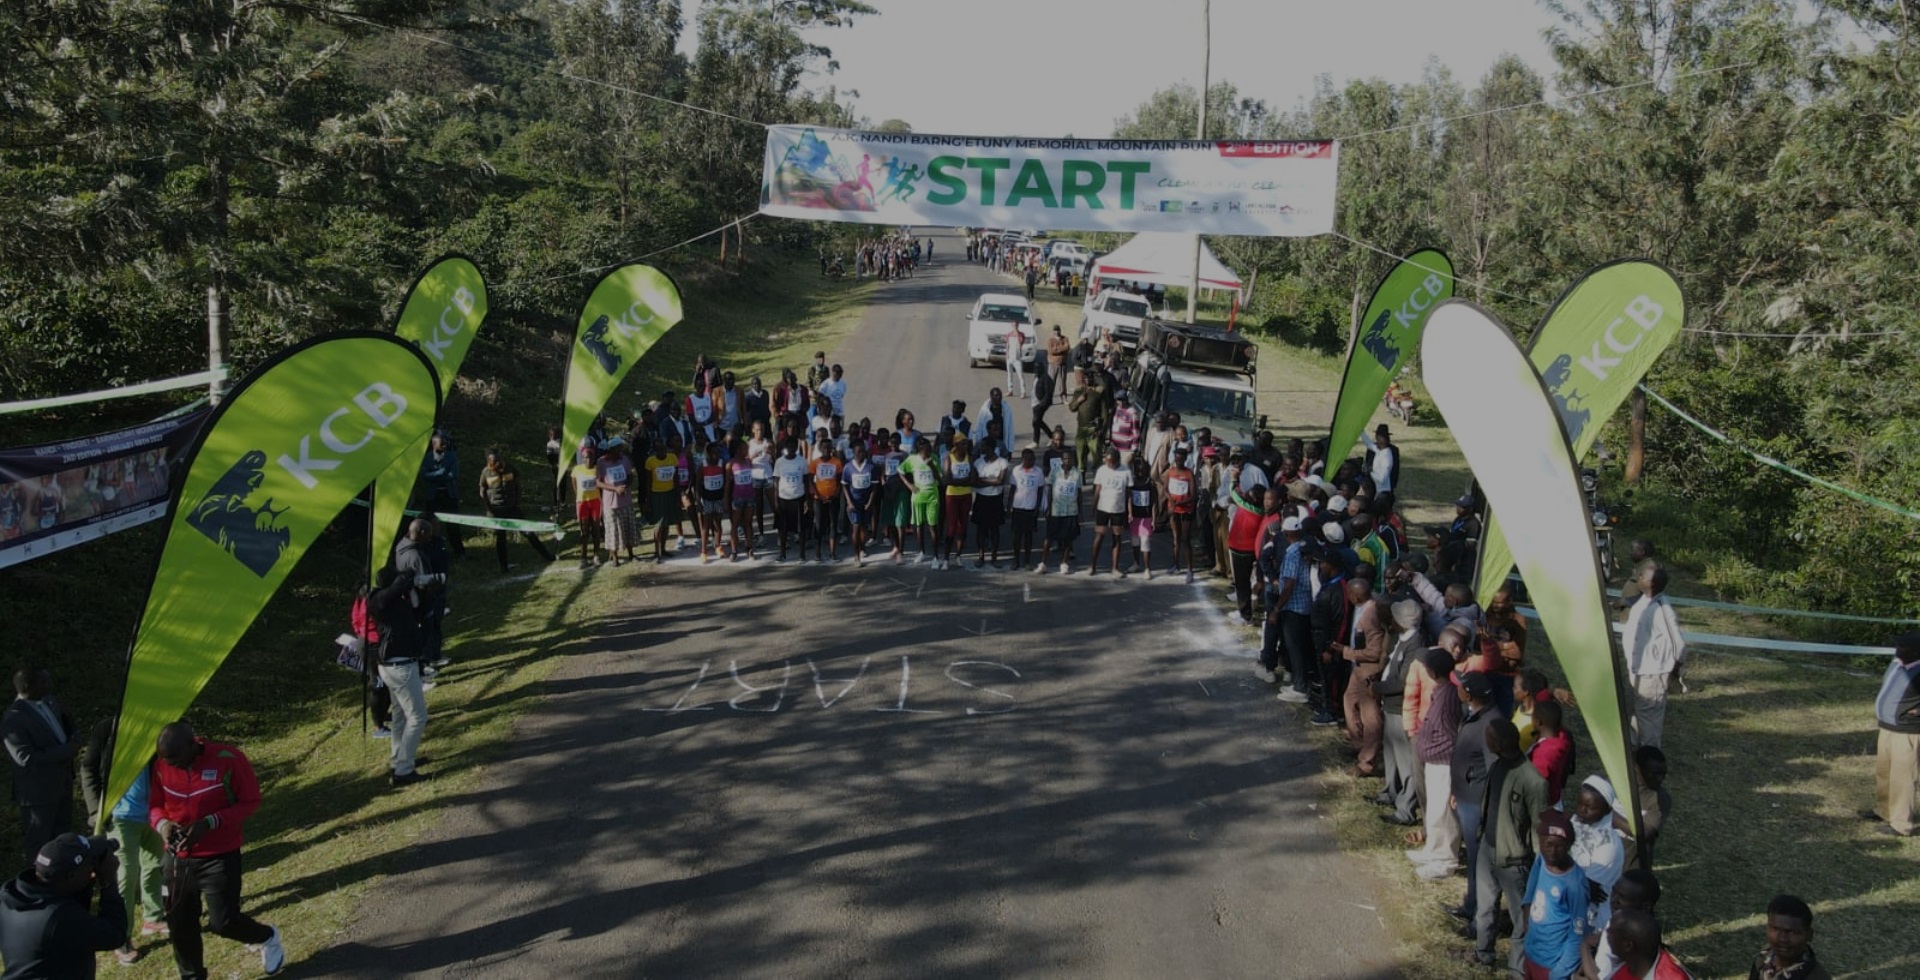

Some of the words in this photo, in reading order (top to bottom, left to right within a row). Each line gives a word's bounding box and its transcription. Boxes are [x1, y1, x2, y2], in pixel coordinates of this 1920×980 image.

[860, 133, 908, 144] NANDI
[1015, 138, 1094, 150] MEMORIAL
[1097, 138, 1176, 151] MOUNTAIN
[1253, 141, 1321, 154] EDITION
[927, 156, 1150, 209] START
[424, 286, 476, 361] KCB
[1394, 271, 1445, 330] KCB
[1577, 293, 1665, 383] KCB
[277, 382, 407, 489] KCB
[642, 655, 1023, 716] START
